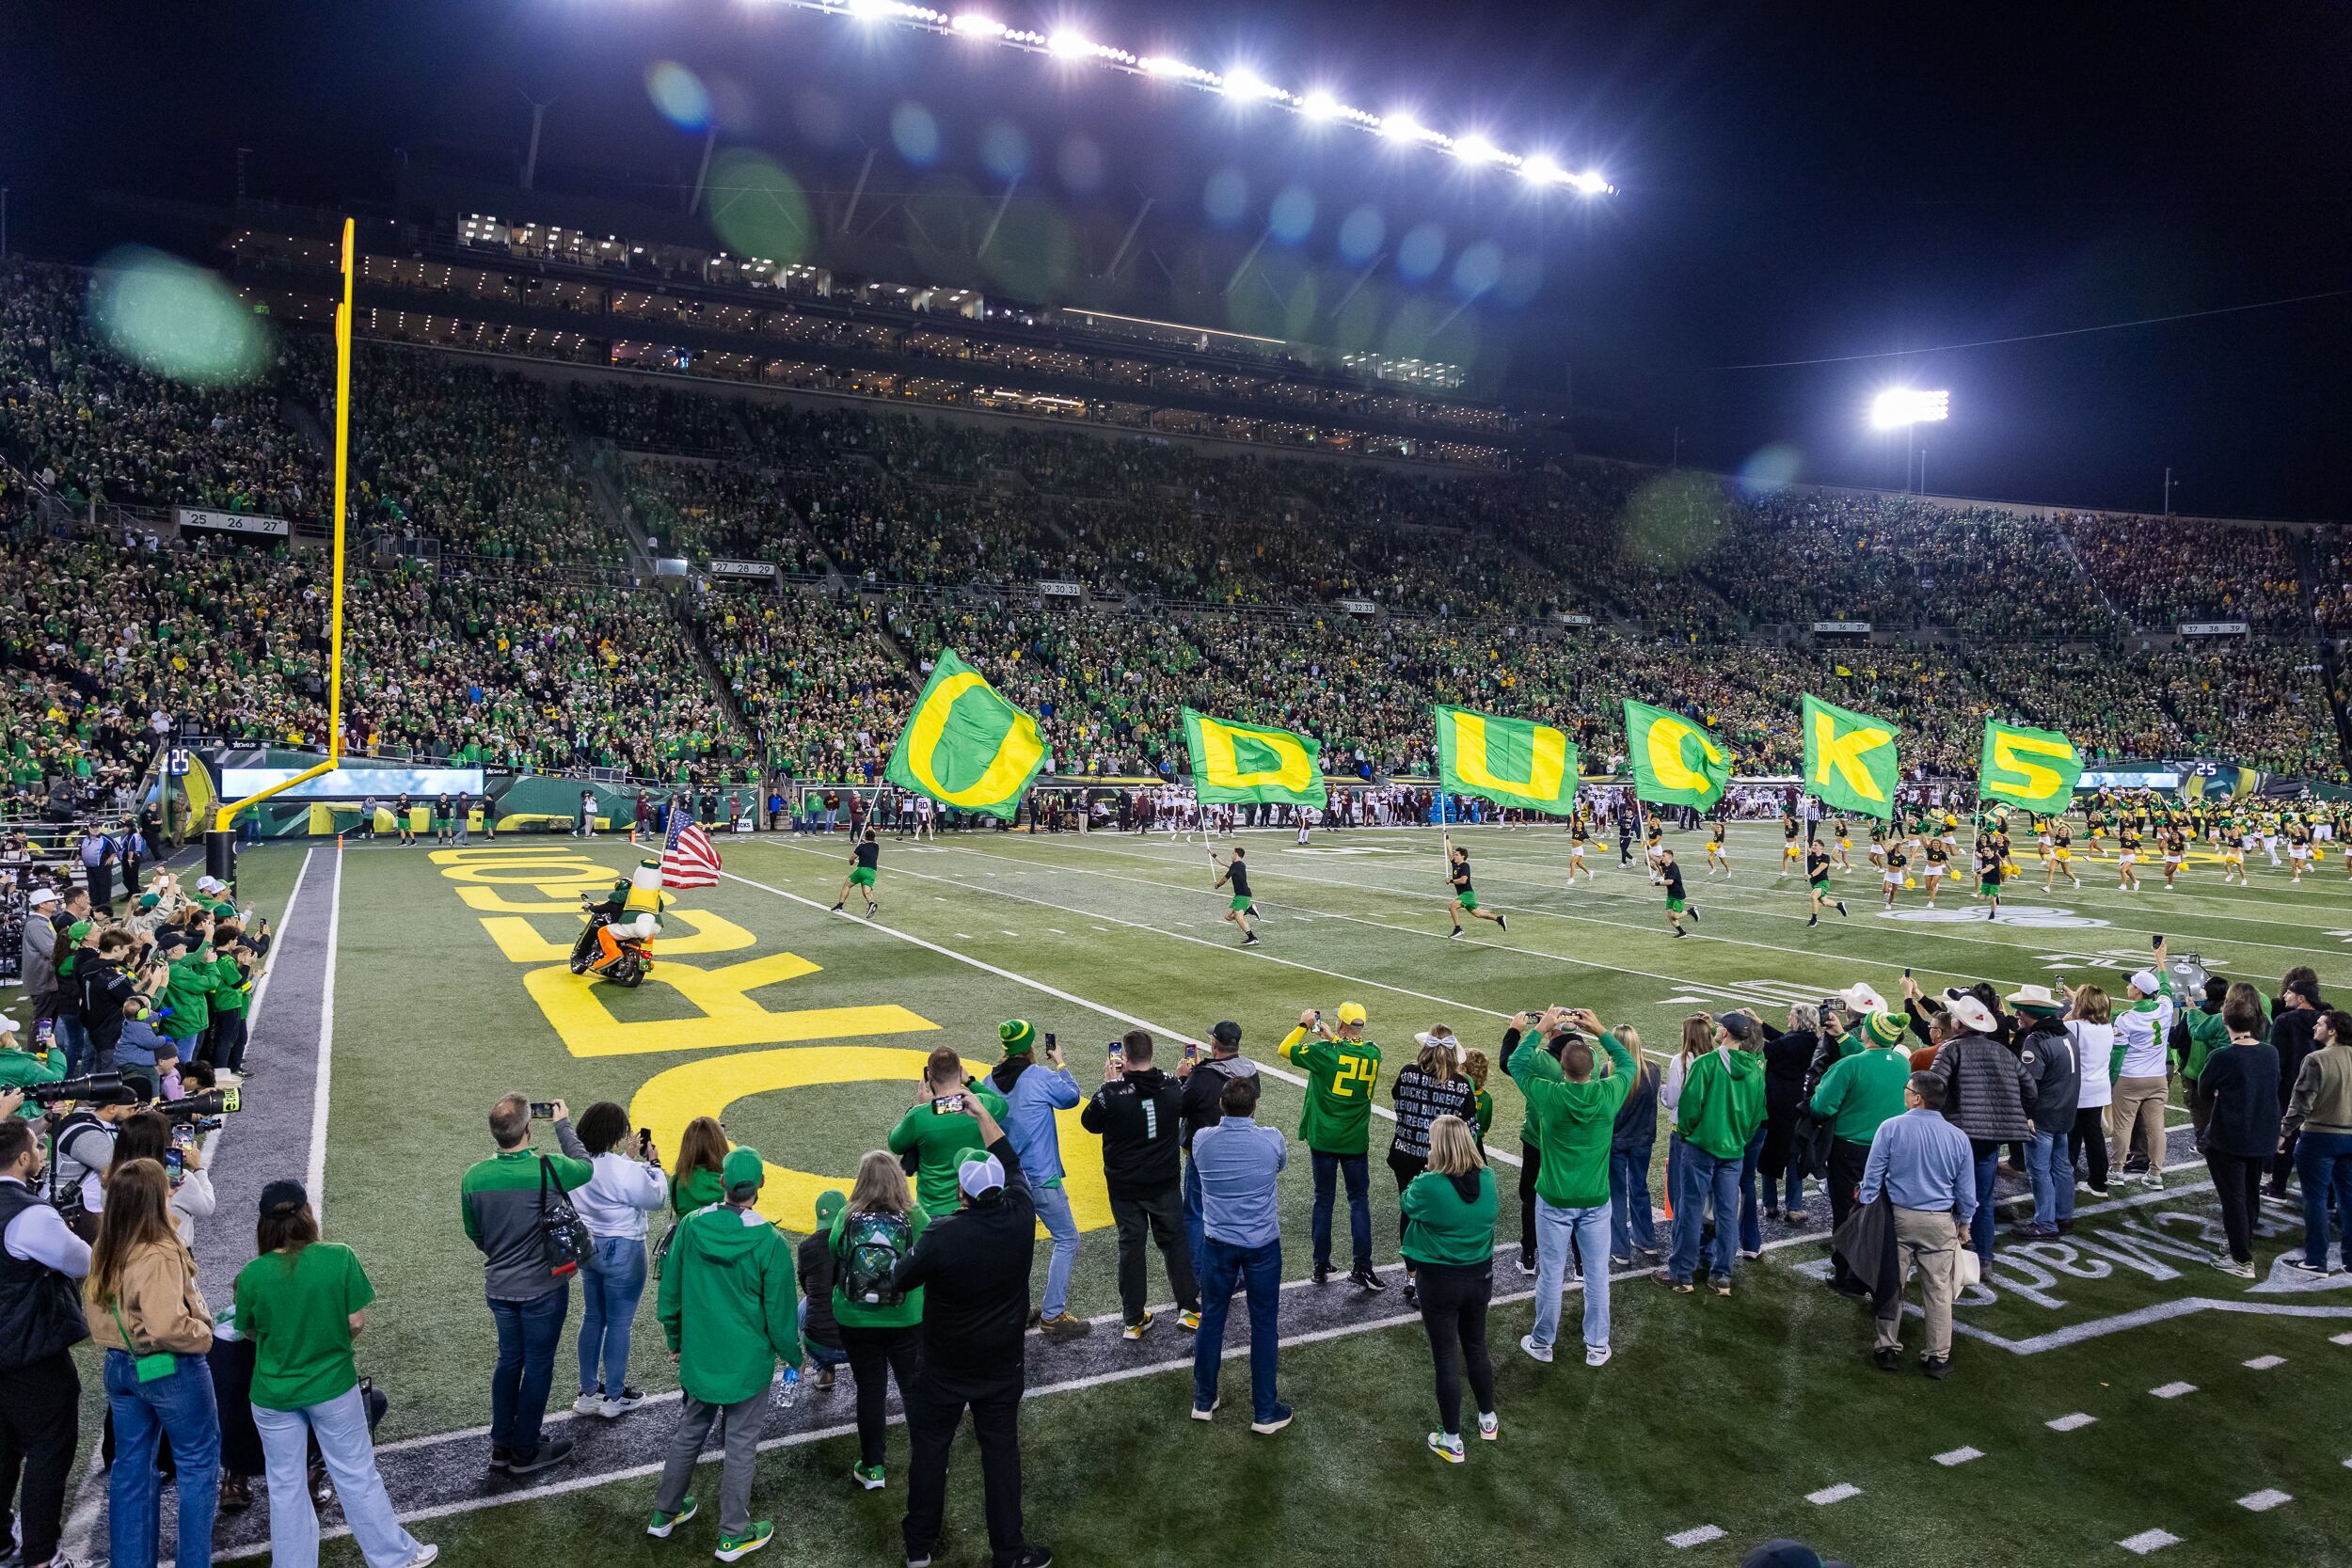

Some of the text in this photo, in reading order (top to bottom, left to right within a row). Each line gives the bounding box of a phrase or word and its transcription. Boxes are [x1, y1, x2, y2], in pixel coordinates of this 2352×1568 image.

[190, 514, 278, 531] 25 26 27
[716, 562, 728, 572] 27
[738, 564, 750, 573] 28
[1041, 584, 1052, 593] 29
[1055, 585, 1065, 594] 30
[909, 669, 1046, 807] O
[1200, 718, 1312, 793] D
[1454, 712, 1566, 800] U
[1647, 718, 1724, 795] C
[1815, 710, 1893, 802] K
[171, 749, 189, 773] 25
[1991, 730, 2073, 800] S
[2196, 762, 2217, 776] 25
[2151, 1020, 2164, 1047] 1
[2062, 1037, 2075, 1074] 1
[1331, 1054, 1378, 1100] 24
[1141, 1098, 1157, 1140] 1
